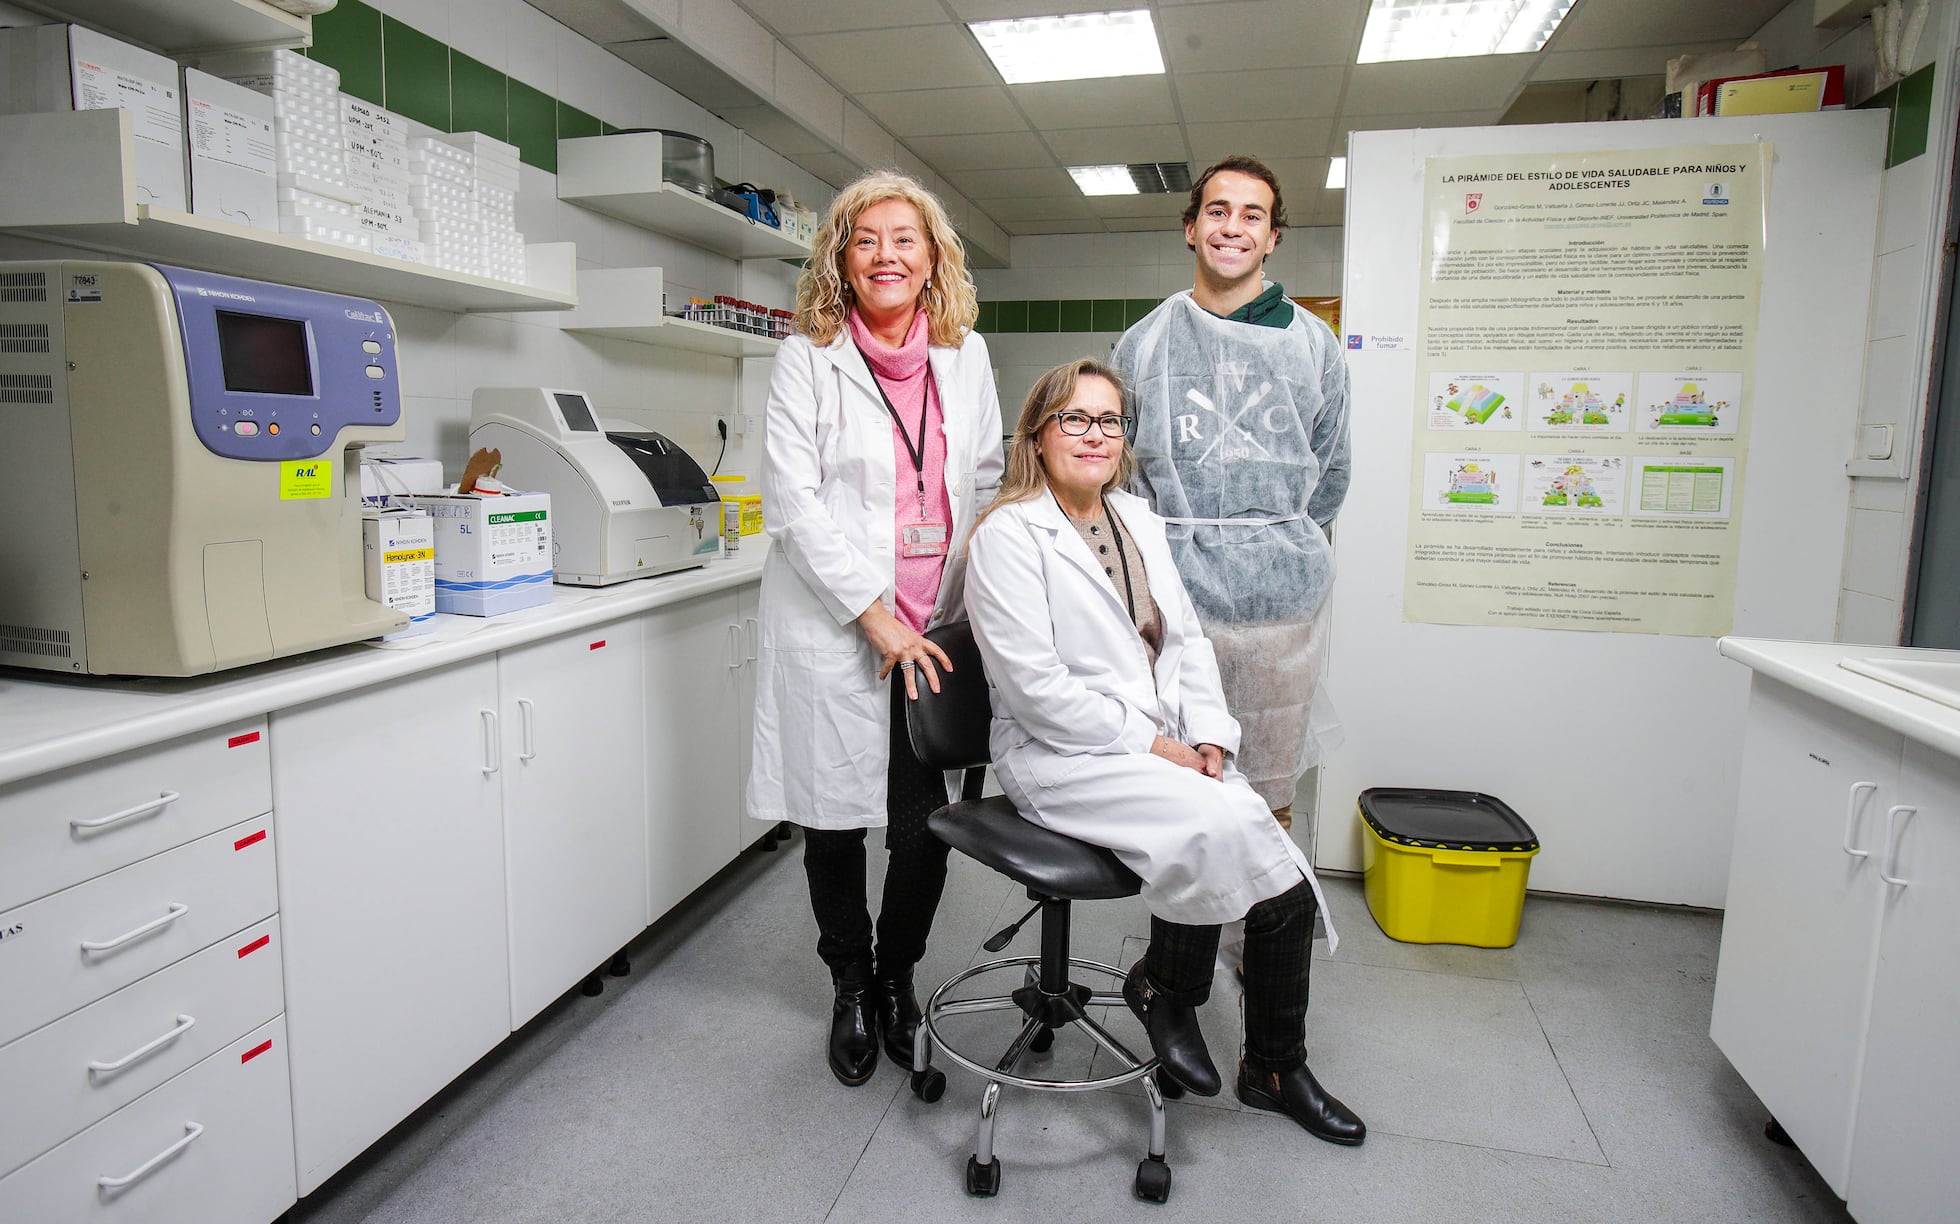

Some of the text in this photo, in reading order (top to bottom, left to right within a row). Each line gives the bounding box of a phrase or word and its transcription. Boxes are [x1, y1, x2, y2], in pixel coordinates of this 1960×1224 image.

[1442, 164, 1746, 184] LA PIRÁMIDE DEL ESTILO DE VIDA SALUDABLE PARA NIÑOS Y
[1549, 180, 1630, 191] ADOLESCENTES
[364, 206, 390, 218] ALEMANIA
[72, 276, 96, 286] 77843
[1229, 362, 1250, 392] V
[1176, 405, 1290, 442] R C
[296, 468, 316, 477] RAL
[490, 514, 516, 523] CLEANAC
[460, 524, 472, 534] 5L
